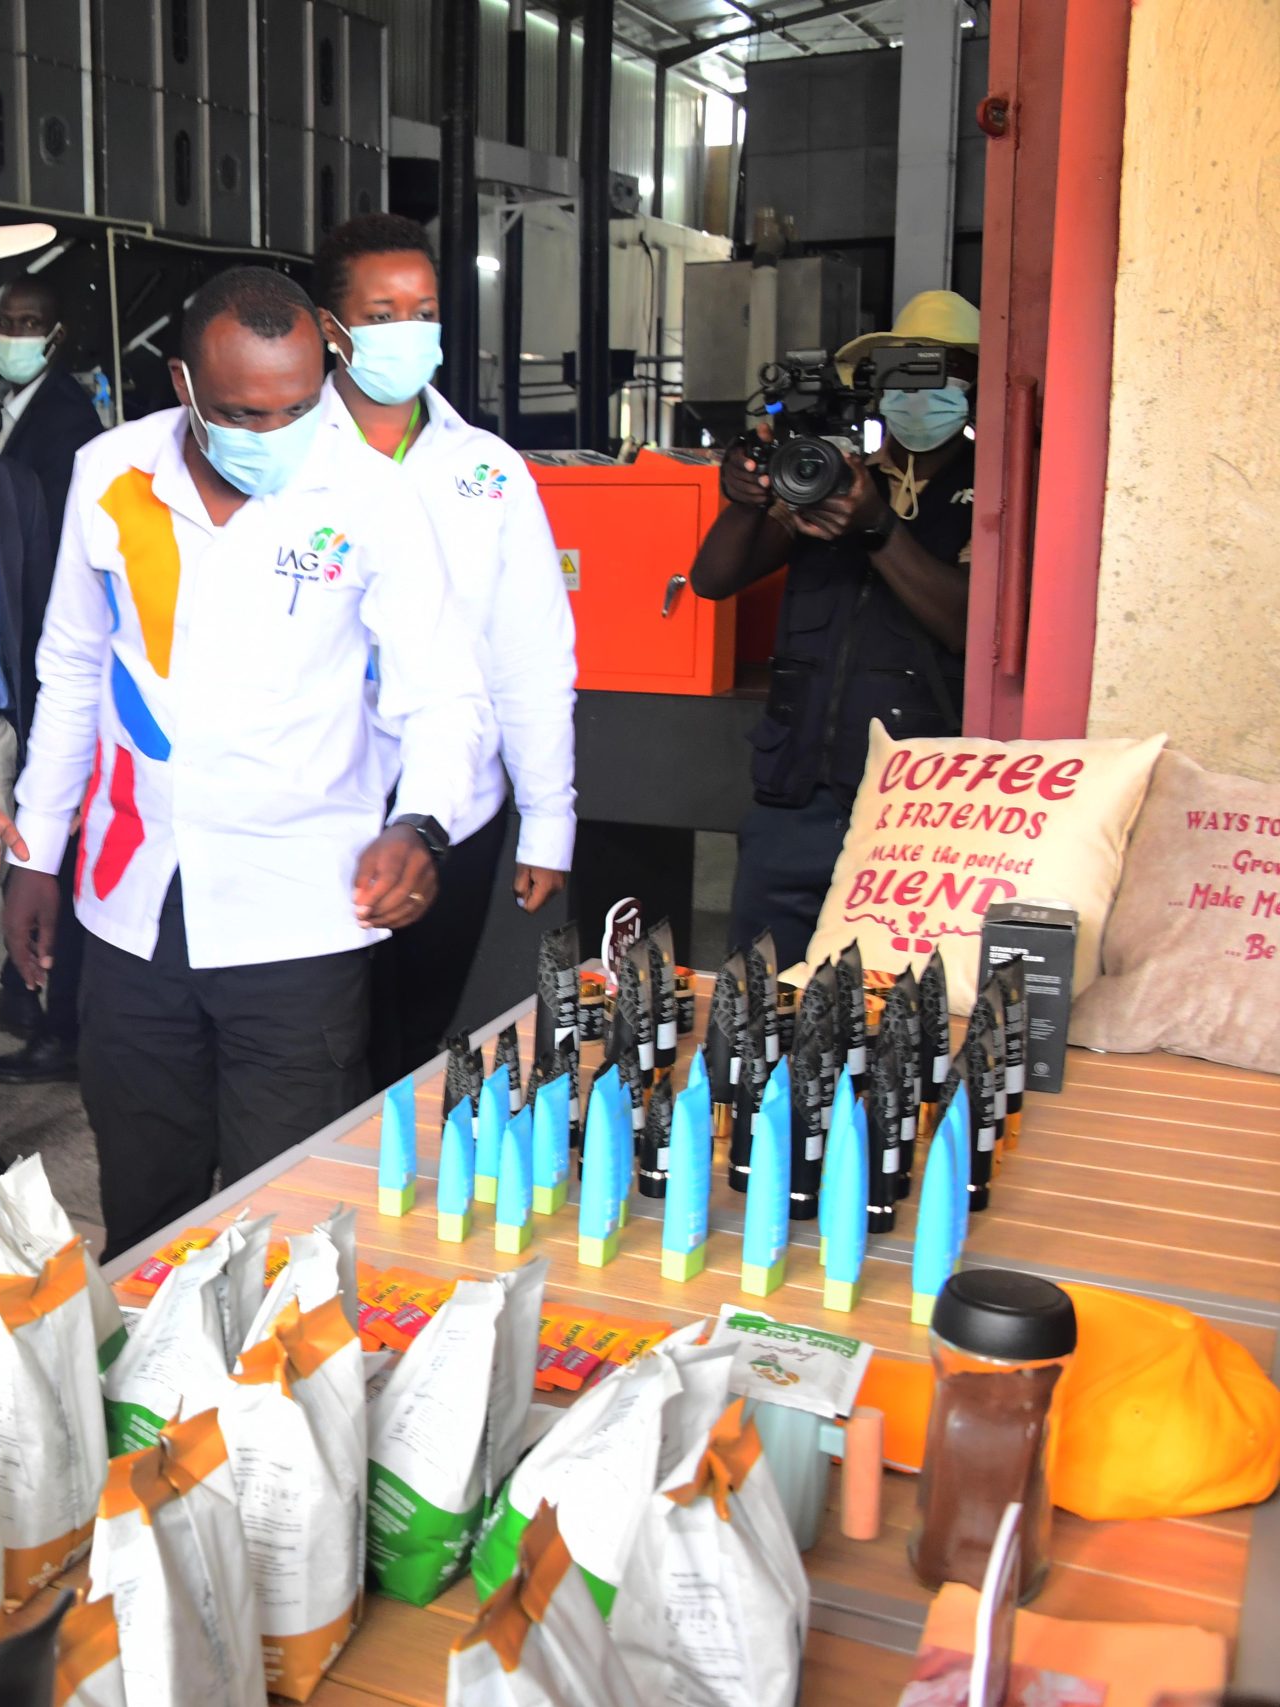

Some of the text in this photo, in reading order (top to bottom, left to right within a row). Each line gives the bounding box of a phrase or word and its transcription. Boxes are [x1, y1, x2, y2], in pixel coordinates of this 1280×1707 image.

[879, 750, 1084, 800] COFFEE
[875, 802, 1048, 840] & FRIENDS
[1186, 810, 1251, 832] WAYS
[869, 844, 1034, 875] MAKE the perfect
[845, 869, 1017, 916] BLEND
